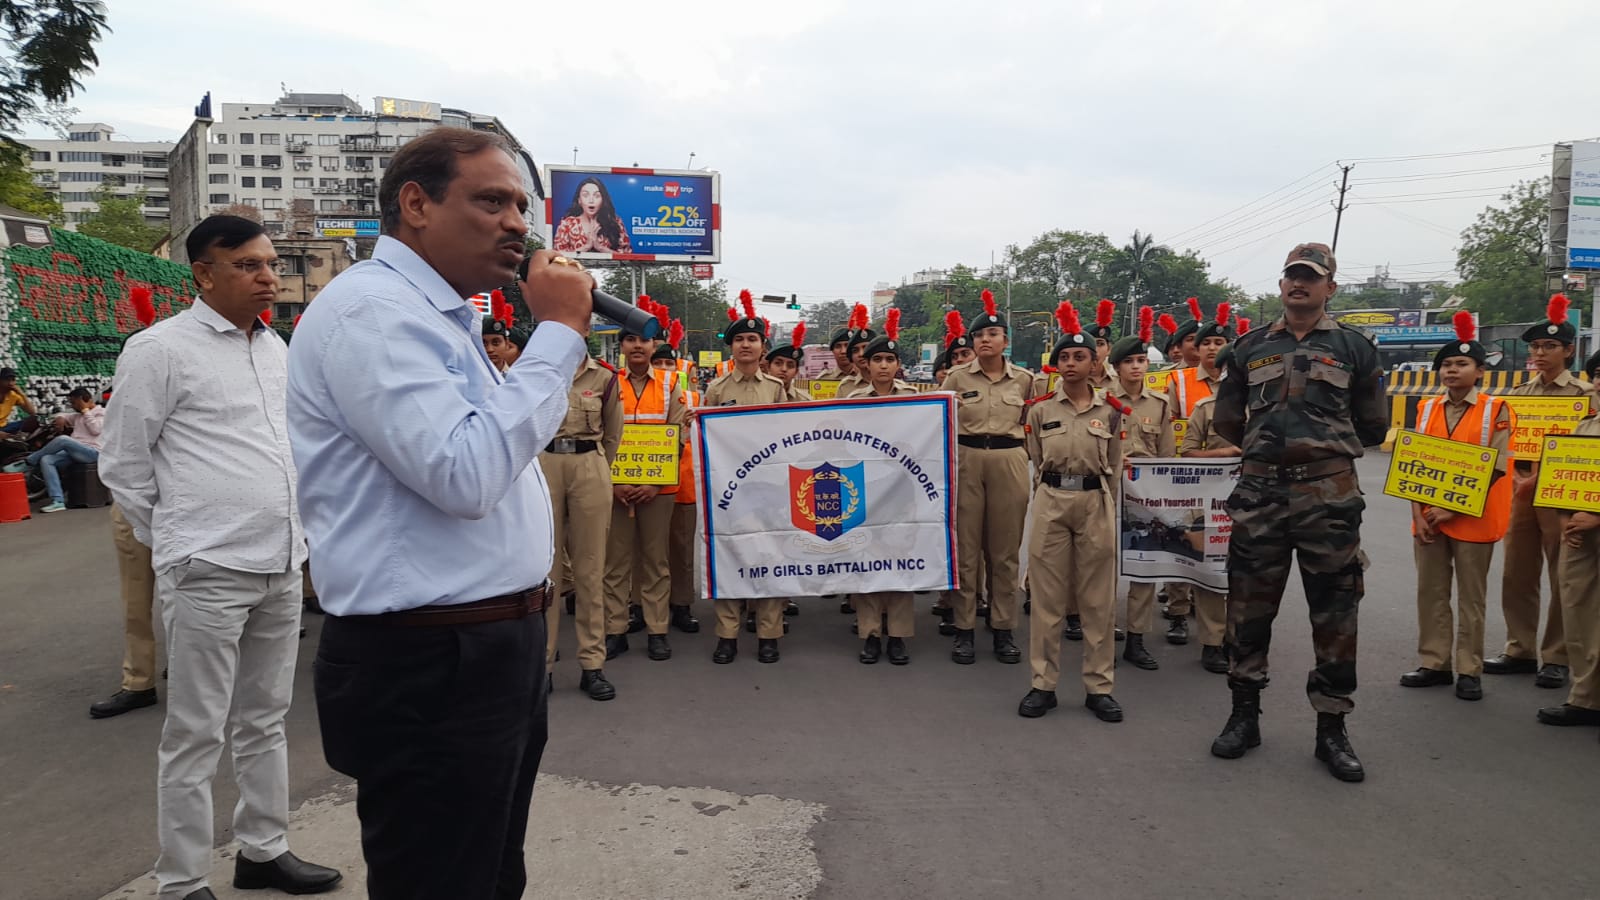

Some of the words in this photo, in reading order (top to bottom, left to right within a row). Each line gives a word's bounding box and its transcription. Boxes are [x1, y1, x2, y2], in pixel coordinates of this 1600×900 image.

[631, 216, 658, 226] FLAT
[632, 453, 645, 462] पर
[648, 453, 673, 463] वाहन
[717, 479, 739, 512] NCC
[735, 442, 779, 480] GROUP
[782, 428, 900, 459] HEADQUARTERS
[899, 454, 940, 503] INDORE
[1156, 467, 1169, 475] MP
[1170, 467, 1193, 476] GIRLS
[1206, 467, 1223, 475] NCC
[1397, 459, 1448, 482] पहिया
[1172, 476, 1201, 484] INDORE
[1397, 475, 1438, 498] इंजन
[1568, 489, 1579, 501] न
[817, 501, 840, 511] NCC
[1145, 498, 1162, 507] Fool
[1163, 498, 1196, 507] Yourself
[1211, 514, 1232, 522] WRO
[737, 568, 745, 578] 1
[749, 565, 769, 578] MP
[773, 564, 813, 578] GIRLS
[817, 559, 892, 576] BATTALION
[897, 558, 926, 571] NCC
